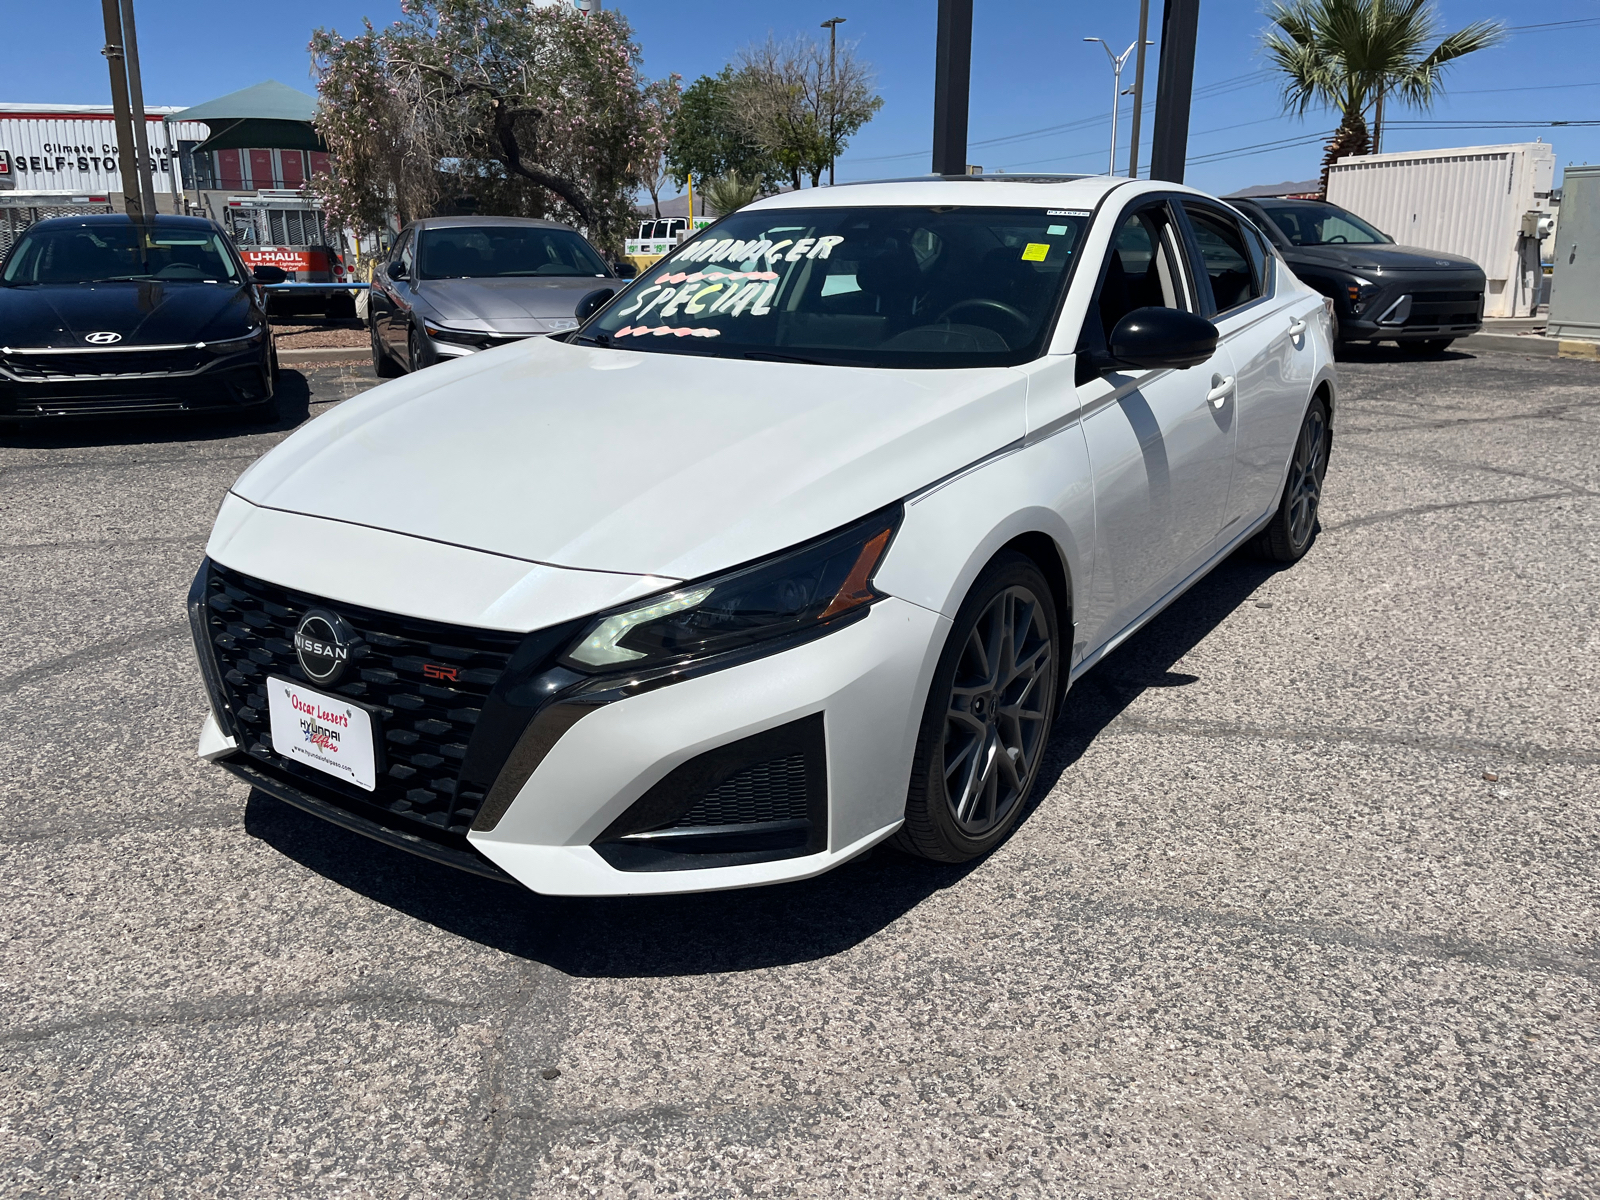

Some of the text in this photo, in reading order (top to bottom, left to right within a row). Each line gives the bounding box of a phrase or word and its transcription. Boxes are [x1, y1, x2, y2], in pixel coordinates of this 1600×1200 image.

[44, 143, 94, 154] Climate
[15, 156, 170, 172] SELF-STOGE
[249, 252, 303, 261] U-HAUL
[670, 236, 845, 264] MANAGER
[618, 283, 777, 320] SPECIAL
[294, 634, 347, 660] NISSAN
[423, 664, 460, 682] SR
[291, 694, 348, 728] Oscar Leeser's
[300, 718, 341, 742] HYUNDAI
